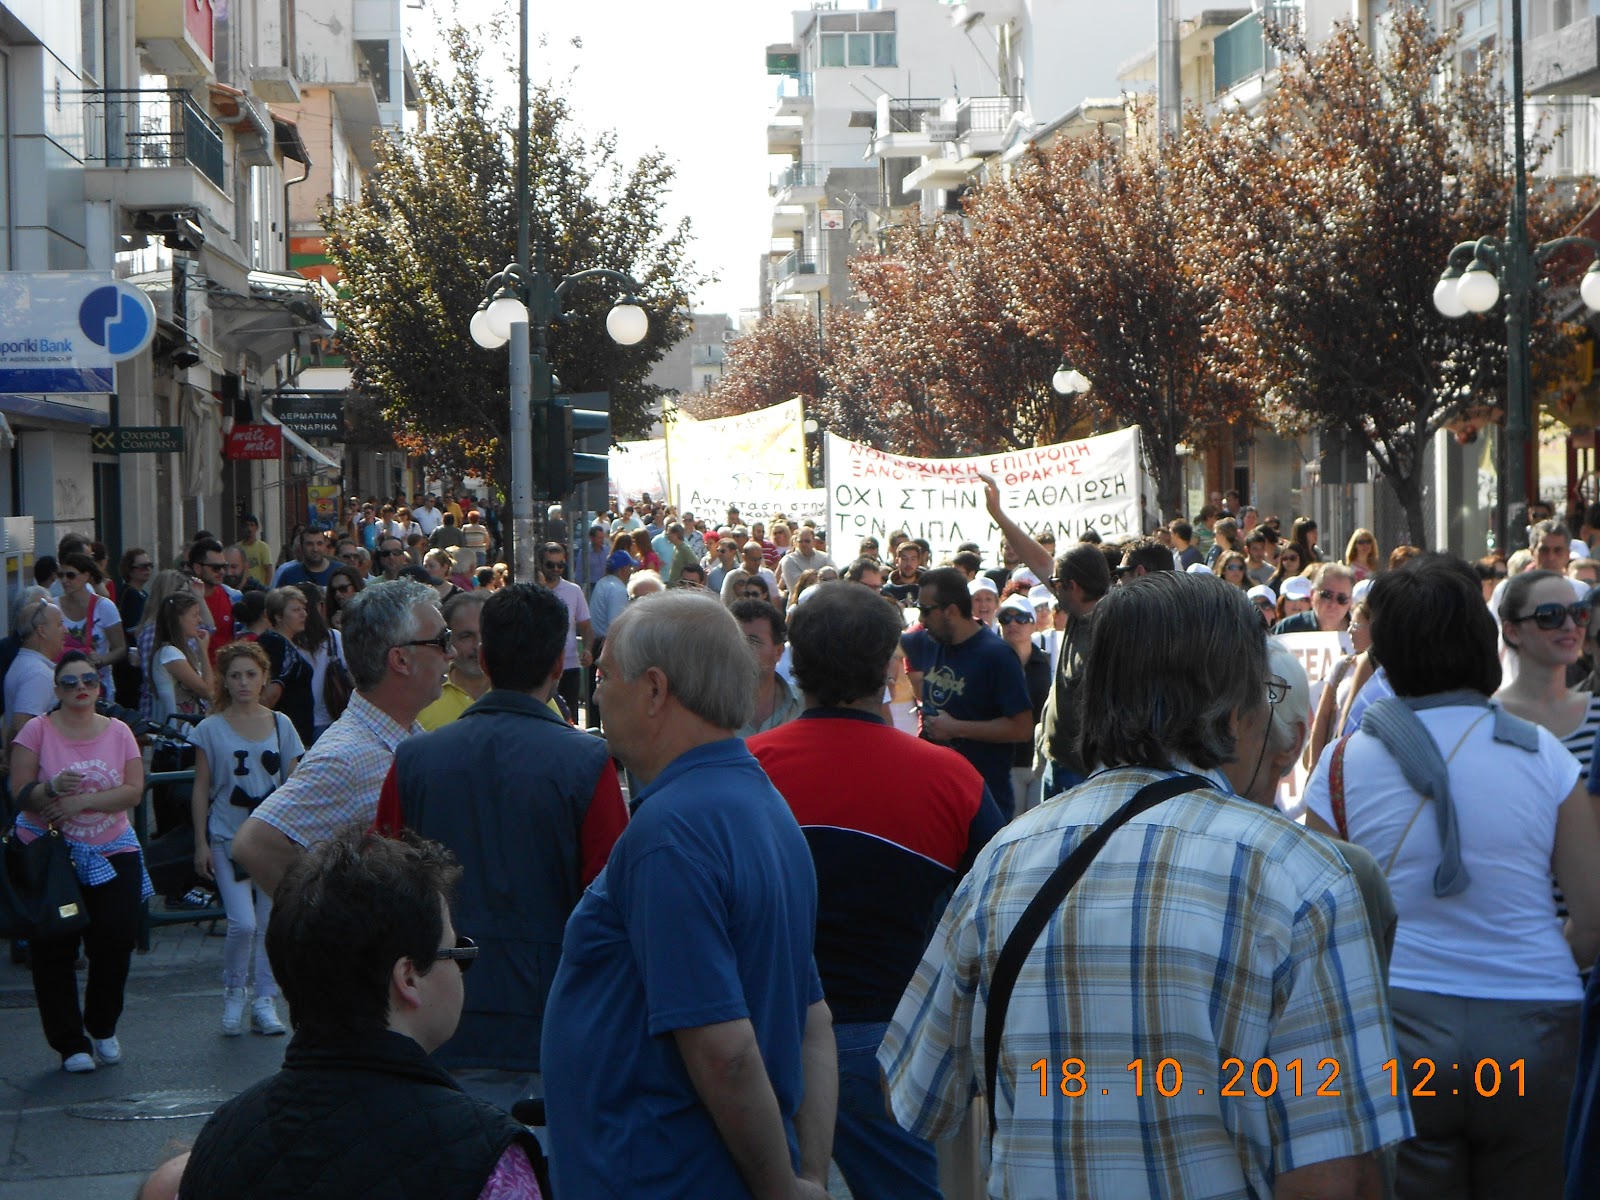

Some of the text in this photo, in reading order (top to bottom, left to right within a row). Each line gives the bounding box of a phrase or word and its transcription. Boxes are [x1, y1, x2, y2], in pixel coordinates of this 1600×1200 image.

[0, 338, 73, 356] poriki Bank
[279, 412, 338, 420] ΔΕΡΜΑΤΙΝΑ
[287, 423, 338, 431] ΟΥΝΑΡΙΚΑ
[121, 431, 170, 440] OXFORD
[121, 440, 177, 449] COMPANY
[990, 442, 1091, 474] ΕΠΙΤΡΟΠΗ
[1004, 459, 1082, 486] ΘΡΑΚΗΣ
[835, 472, 1127, 510] ΟΧΙ ΣΤΗΝ ΞΑΘΛΙΩΣΗ
[835, 512, 886, 540] ΤΩΝ
[987, 510, 1129, 542] ΜΧΑΝΙΚΩΝ
[233, 750, 249, 776] I
